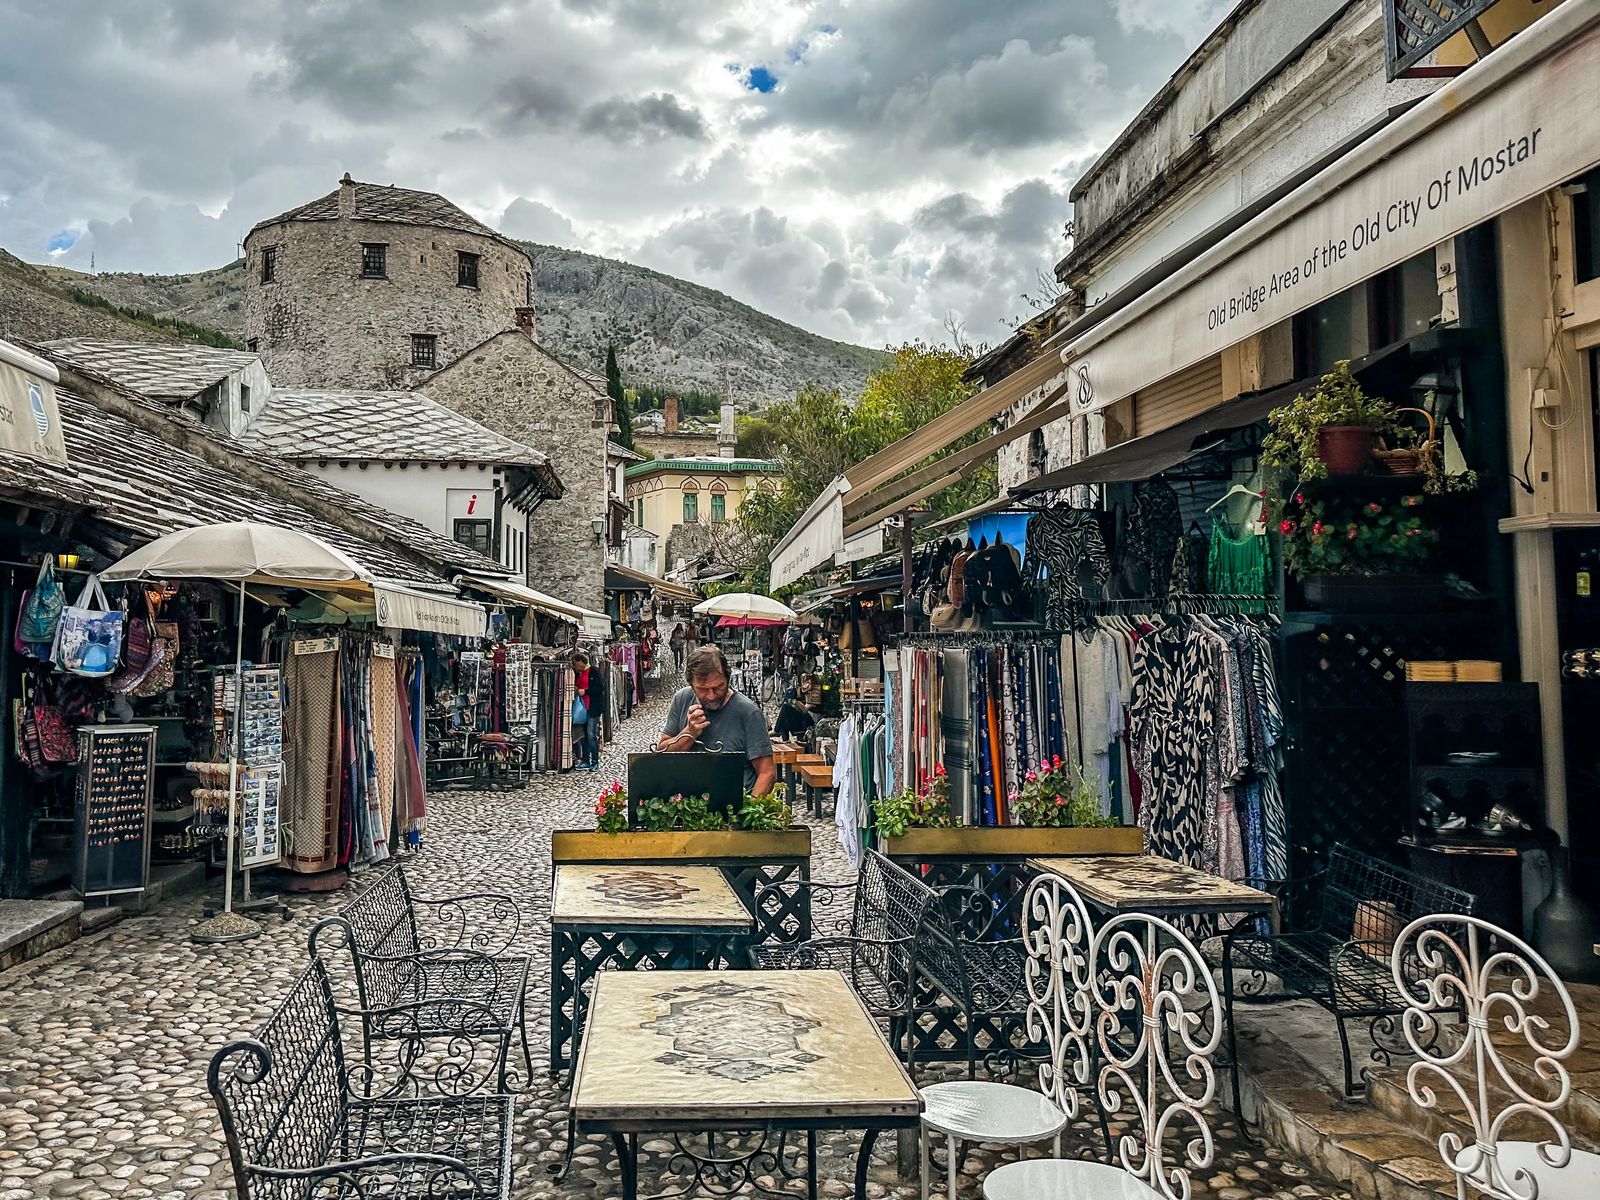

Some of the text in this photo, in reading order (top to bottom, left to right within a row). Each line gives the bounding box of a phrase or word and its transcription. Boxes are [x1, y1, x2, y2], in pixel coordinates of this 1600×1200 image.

[1208, 127, 1541, 331] Old Bridge Area of the Old City Of Mostar
